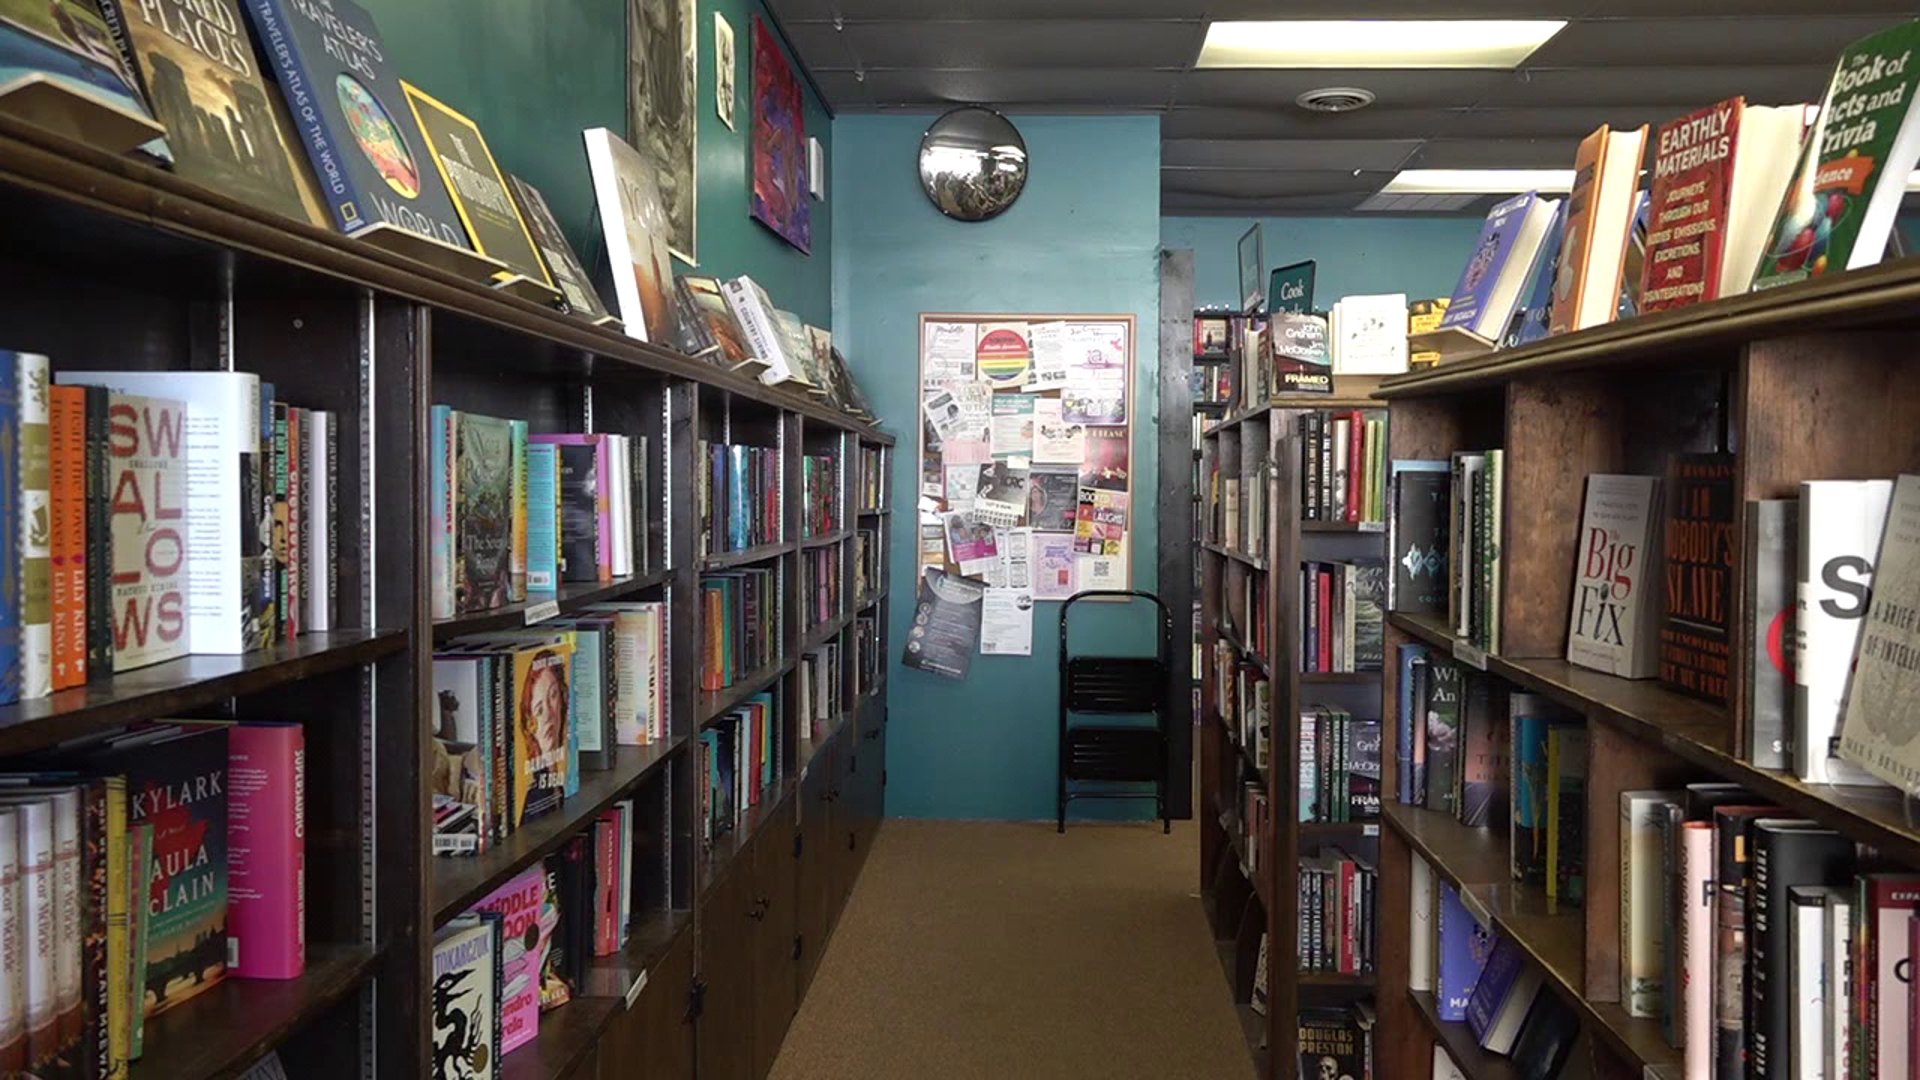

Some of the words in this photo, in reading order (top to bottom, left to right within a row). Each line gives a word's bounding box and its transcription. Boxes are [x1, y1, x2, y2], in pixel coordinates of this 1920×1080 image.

[323, 34, 375, 80] ATLAS
[1886, 50, 1911, 76] of
[1867, 82, 1907, 111] and
[287, 70, 308, 108] ATLAS
[302, 107, 315, 124] OF
[310, 125, 326, 149] THE
[320, 151, 345, 195] WORLD
[1660, 108, 1731, 155] EARTHLY
[1655, 136, 1730, 178] MATERIALS
[1281, 279, 1304, 301] Cook
[1666, 266, 1684, 280] AND
[1285, 374, 1329, 385] FRAMED
[444, 416, 452, 535] ATMOSPHERE
[1583, 527, 1636, 601] Big
[55, 572, 66, 605] LILY
[73, 569, 84, 604] LILY
[1667, 563, 1724, 624] SLAVE
[56, 611, 67, 656] KING
[74, 609, 85, 652] KING
[132, 771, 222, 820] KYLARK
[296, 748, 304, 838] SUPERSAURIO
[150, 844, 209, 883] AULA
[1756, 894, 1767, 909] IS
[1756, 912, 1767, 932] NO
[434, 933, 490, 977] TOKARCZUK
[98, 968, 107, 1005] IAN
[98, 1012, 107, 1080] McEWA
[1299, 1027, 1353, 1042] DOUGLAS
[1299, 1040, 1354, 1055] PRESTON
